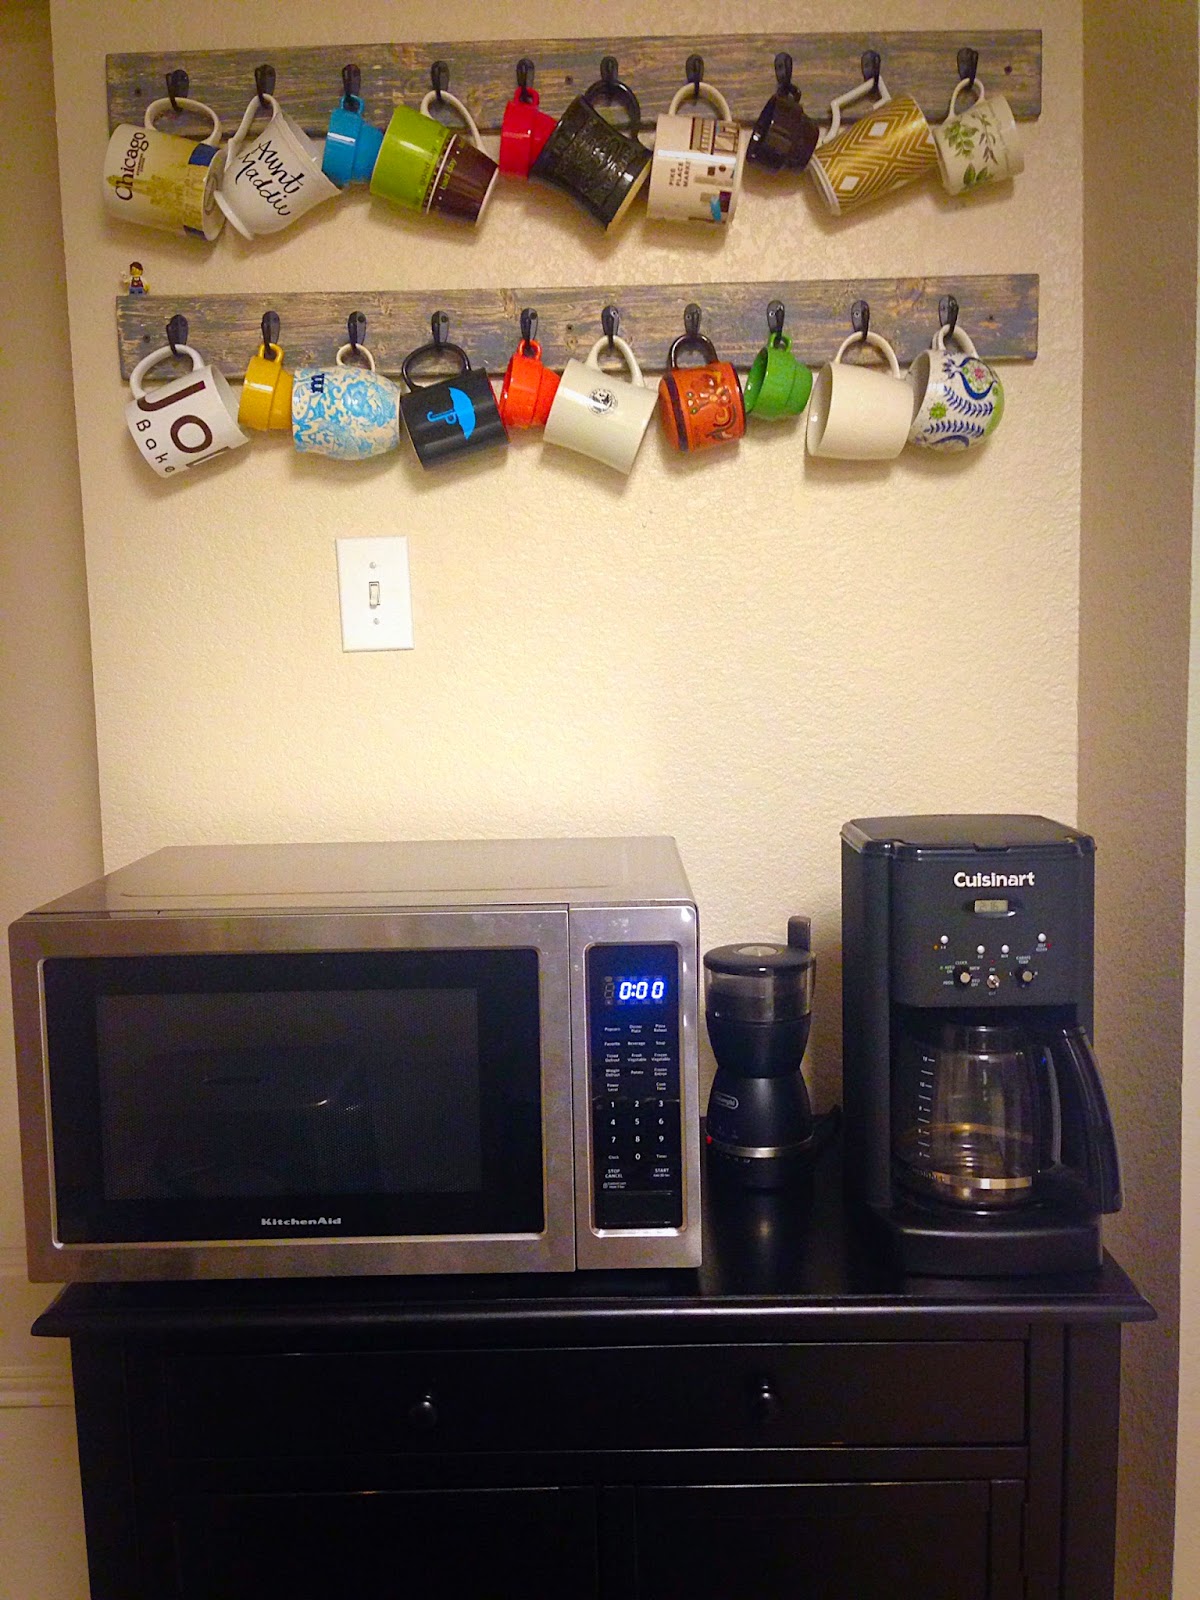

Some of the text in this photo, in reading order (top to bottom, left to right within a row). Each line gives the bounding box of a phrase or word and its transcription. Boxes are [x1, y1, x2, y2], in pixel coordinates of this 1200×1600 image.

[115, 132, 149, 201] Chicago
[251, 140, 306, 195] Aunt
[439, 157, 458, 190] bad day
[676, 162, 684, 186] PLACE
[235, 153, 291, 216] Maddie
[136, 419, 176, 473] Bake
[953, 871, 1035, 887] Cuisinart
[619, 981, 665, 1000] 0:00
[634, 1117, 640, 1125] 5
[261, 1217, 342, 1226] KitchenAid
